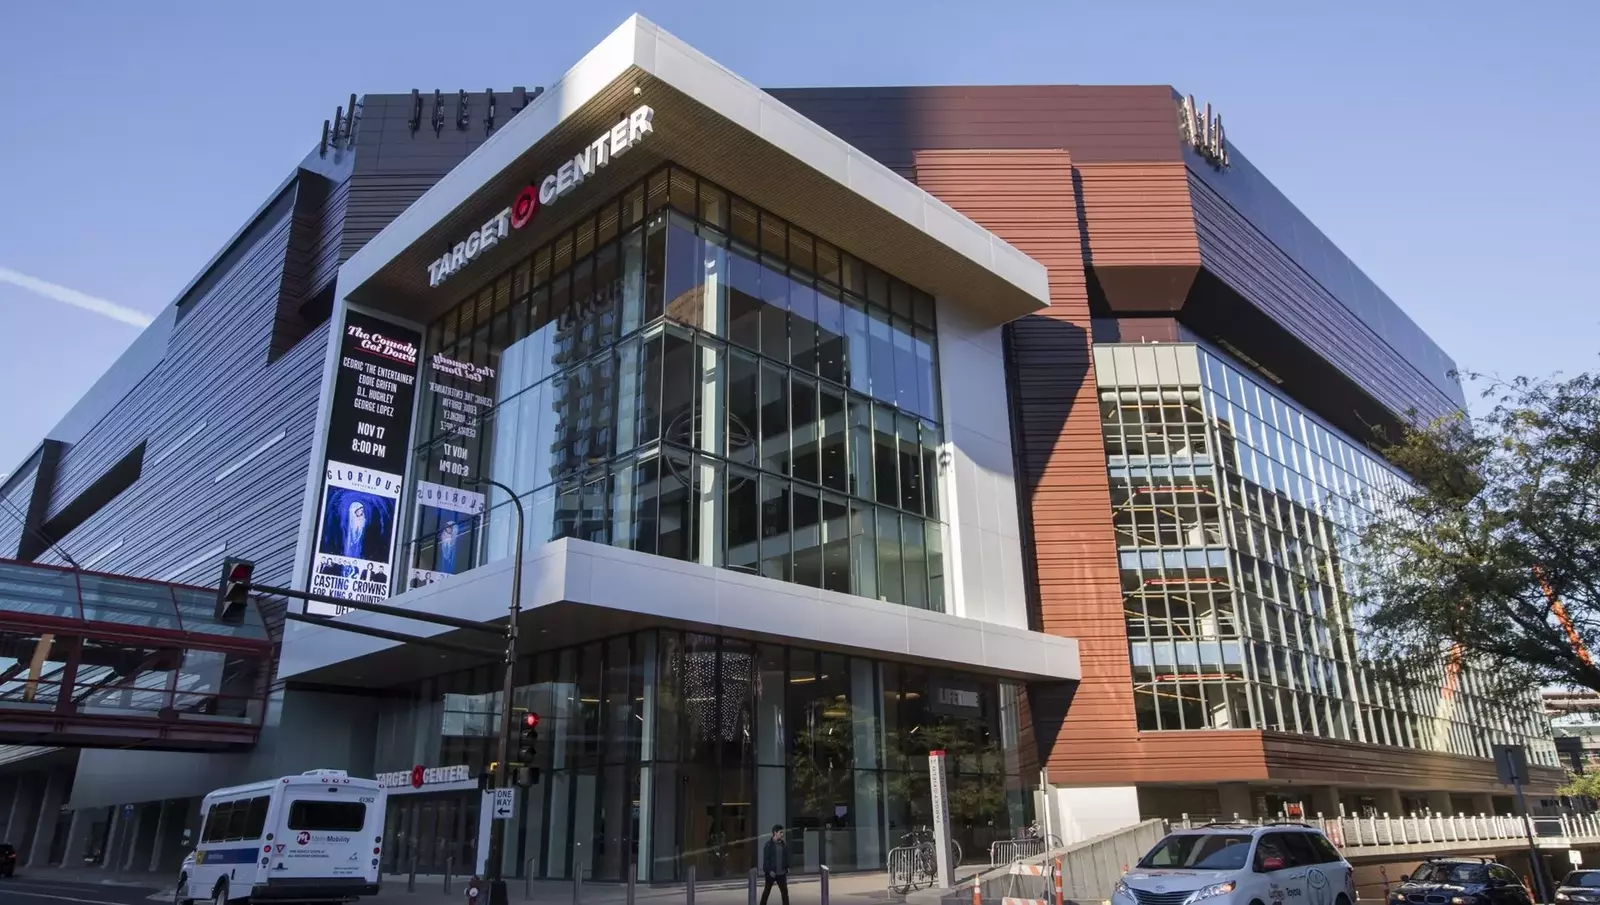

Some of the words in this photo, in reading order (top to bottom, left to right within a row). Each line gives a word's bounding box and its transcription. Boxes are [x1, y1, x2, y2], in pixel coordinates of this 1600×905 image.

[427, 206, 512, 288] TARGET
[539, 104, 654, 206] CENTER
[348, 325, 370, 340] The
[372, 334, 417, 356] Comedy
[343, 356, 364, 371] CEDRIC
[382, 346, 416, 363] Down
[359, 374, 375, 387] EDDIE
[376, 378, 398, 393] GRIFFIN
[356, 386, 367, 398] D.L.
[368, 389, 394, 404] HUGHLEY
[354, 398, 375, 413] GEORGE
[376, 404, 394, 417] LOPEZ
[358, 422, 376, 437] NOV
[377, 426, 385, 439] 17
[352, 438, 371, 454] 8:00
[372, 443, 386, 458] PM
[327, 470, 401, 494] GLORIOUS
[314, 574, 348, 590] CASTING
[353, 580, 387, 596] CROWNS
[376, 770, 412, 787] TARGET
[423, 765, 470, 783] CENTER
